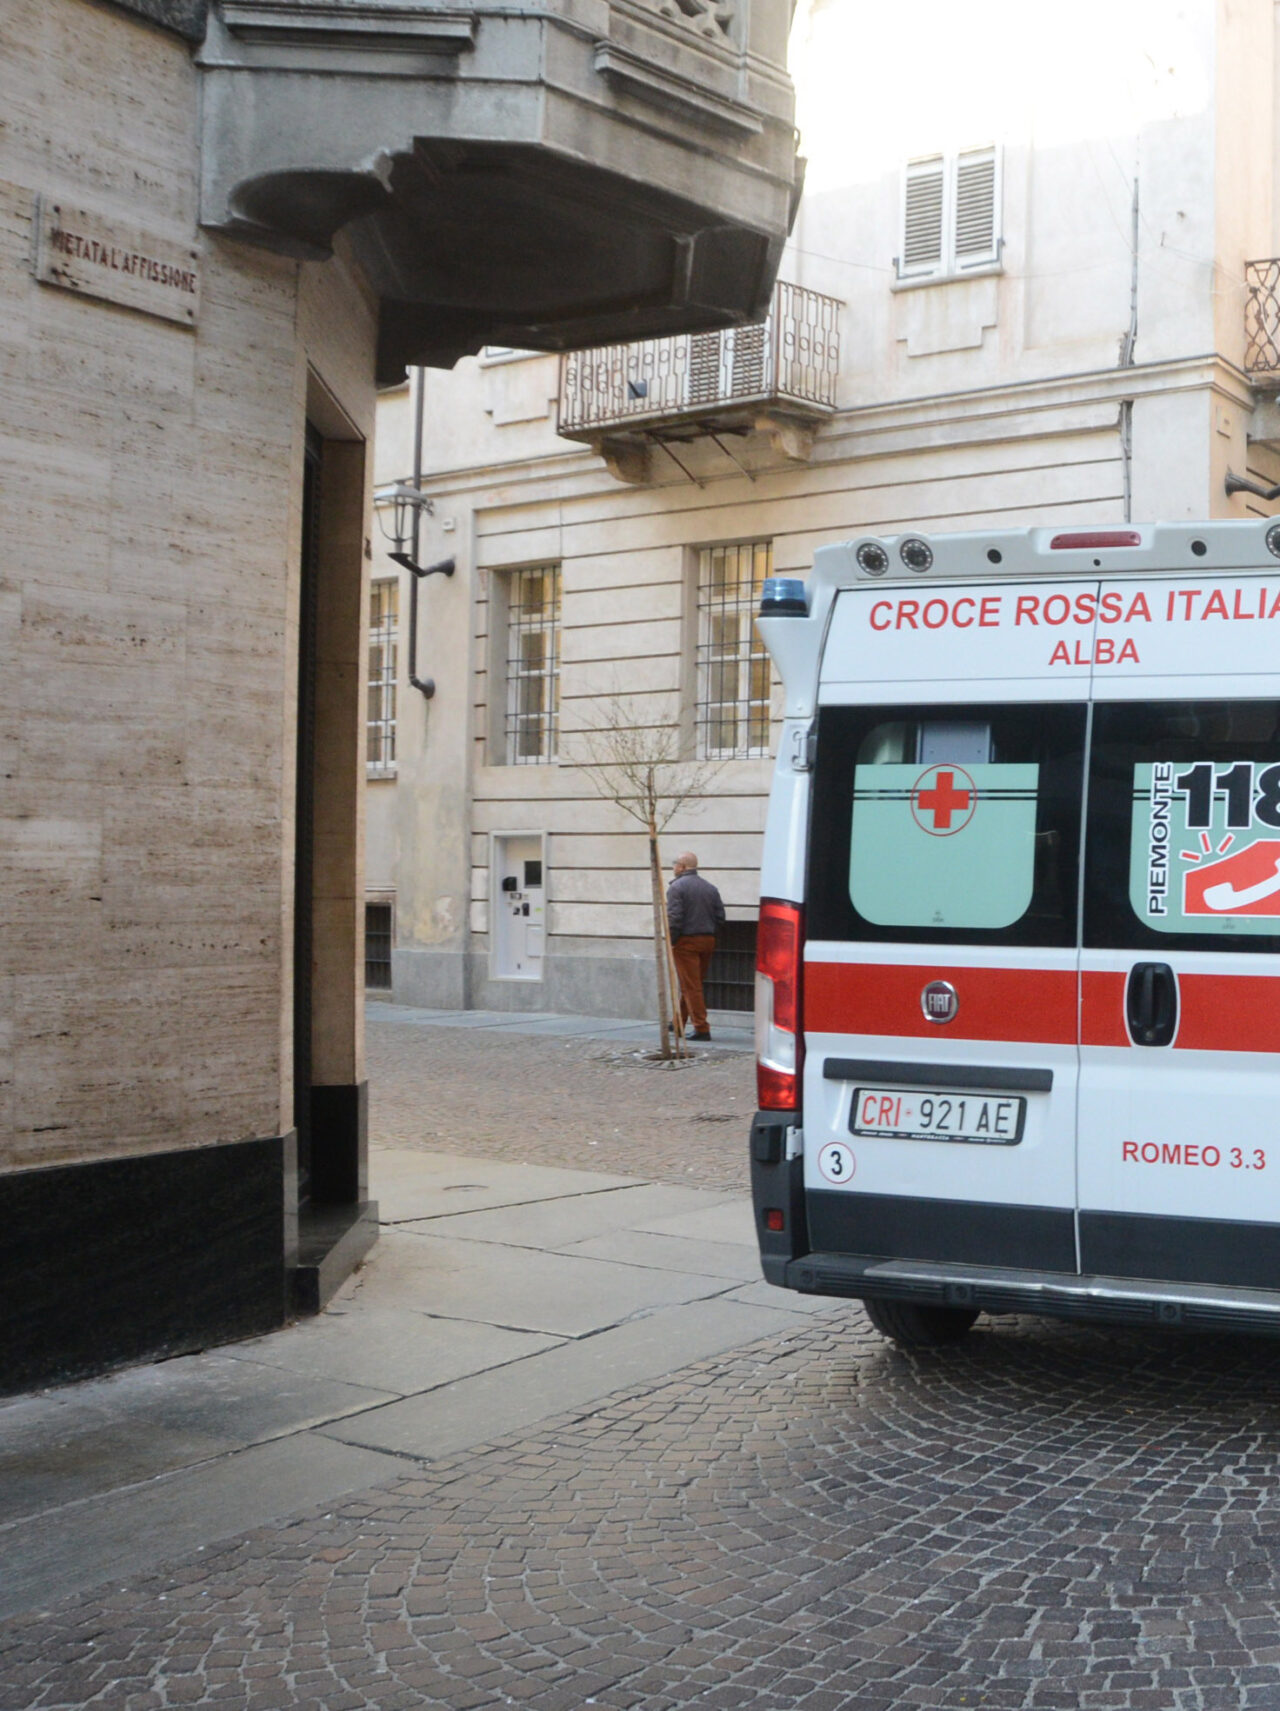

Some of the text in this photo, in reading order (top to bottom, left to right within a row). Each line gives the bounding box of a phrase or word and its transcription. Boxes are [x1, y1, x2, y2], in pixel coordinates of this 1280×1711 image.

[869, 597, 1001, 631] CROCE
[1014, 592, 1152, 627] ROSSA
[1048, 638, 1141, 666] ALBA
[1149, 763, 1172, 914] PIEMONTE
[928, 993, 951, 1012] FIAT
[862, 1095, 902, 1127] CRI
[830, 1150, 844, 1176] 3
[1122, 1141, 1267, 1171] ROMEO 3.3
